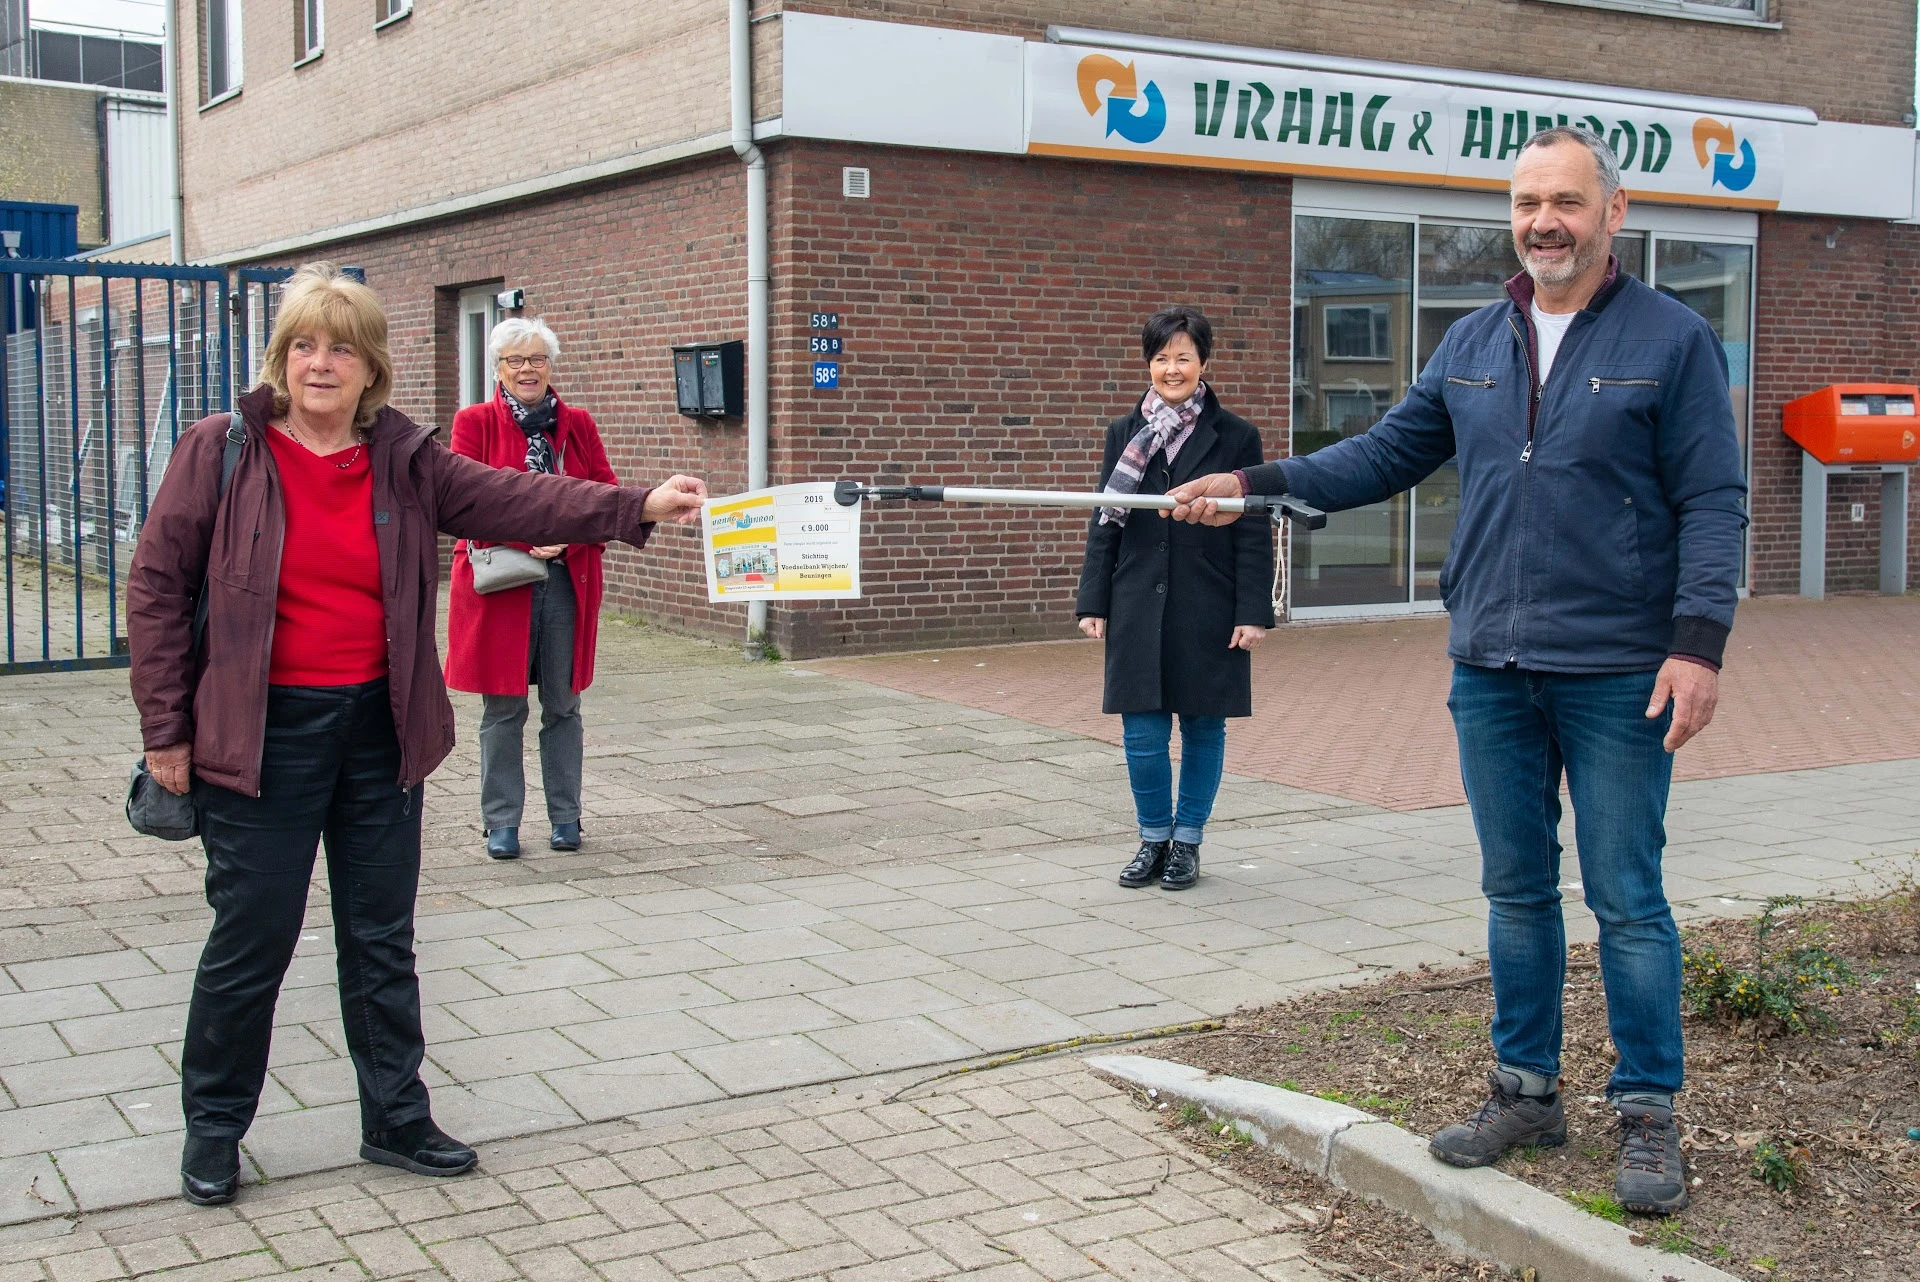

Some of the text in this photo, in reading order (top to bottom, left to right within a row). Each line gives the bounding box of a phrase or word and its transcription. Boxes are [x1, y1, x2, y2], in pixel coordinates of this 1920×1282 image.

[1194, 79, 1395, 152] VRAAG
[1408, 110, 1434, 156] &
[812, 314, 837, 327] 58 A
[811, 338, 838, 351] 58 B
[804, 495, 824, 503] 2019
